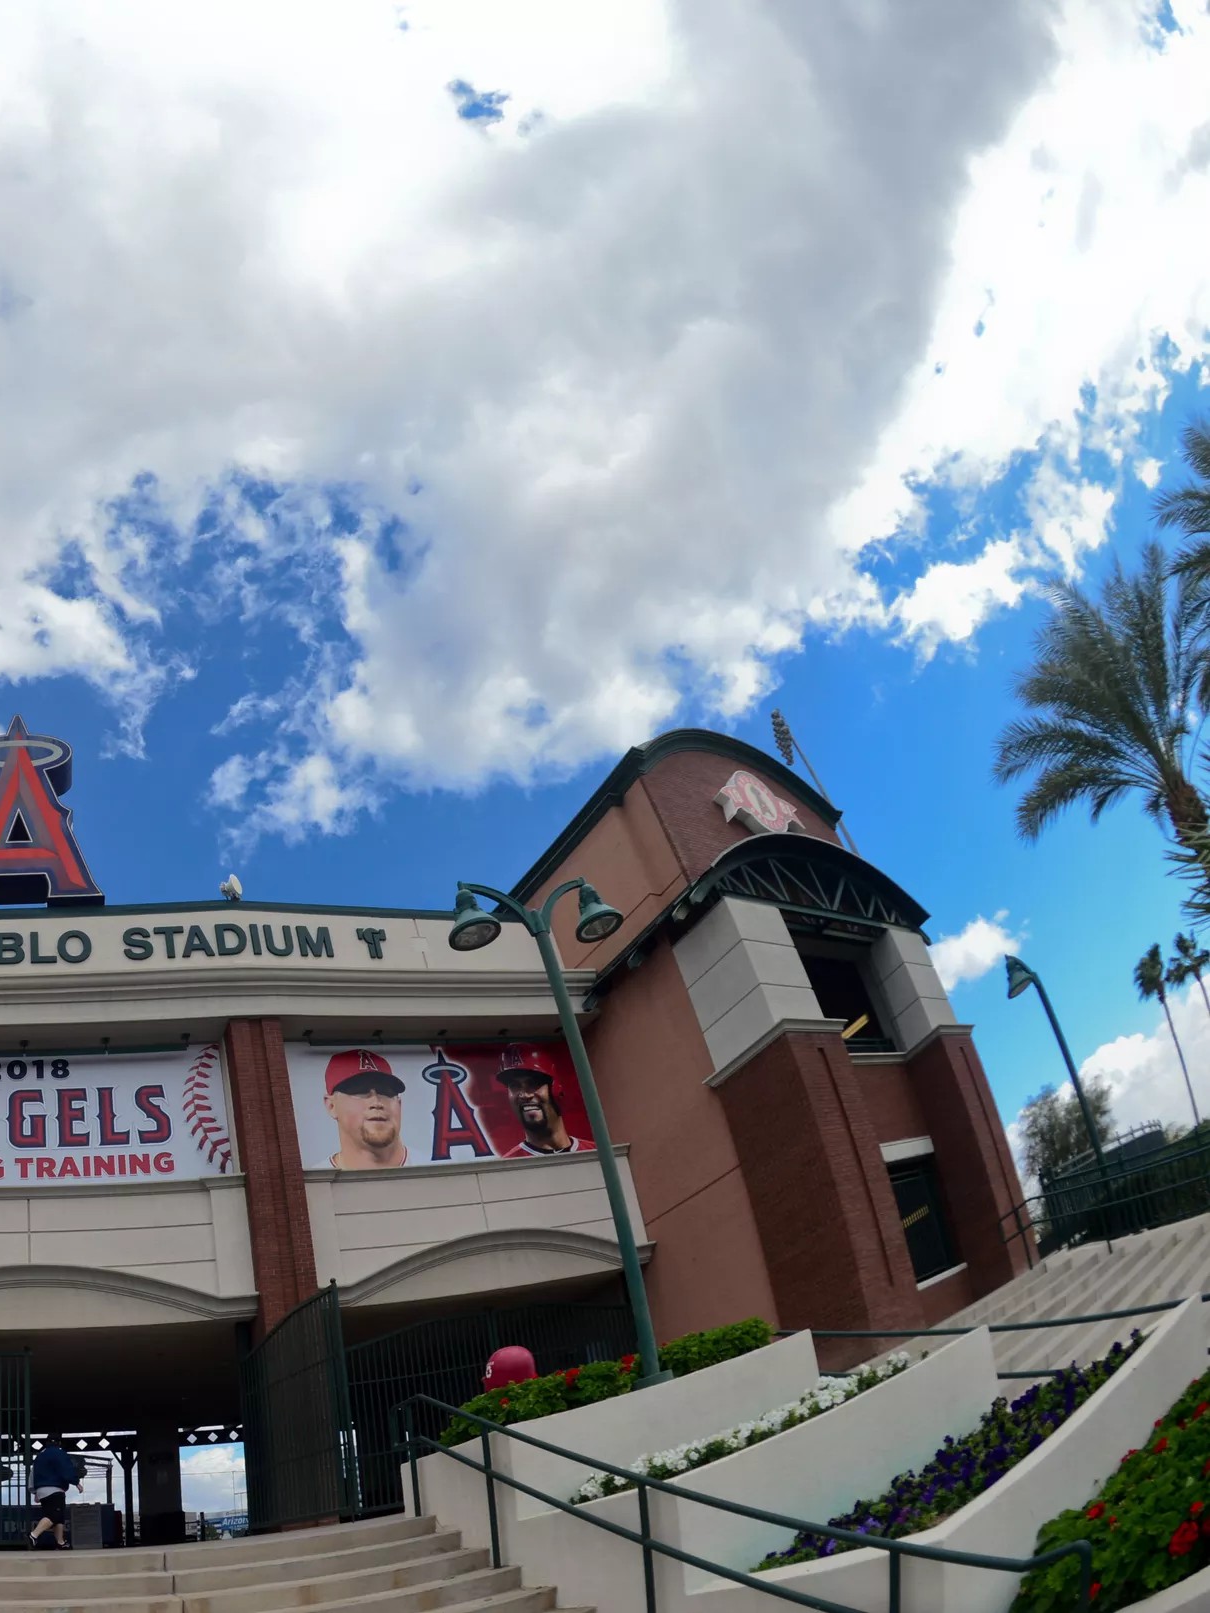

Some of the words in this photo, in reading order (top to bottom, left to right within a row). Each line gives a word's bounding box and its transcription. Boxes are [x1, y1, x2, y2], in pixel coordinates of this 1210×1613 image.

[122, 923, 335, 961] STADIUM
[358, 1050, 378, 1071] A
[422, 1048, 495, 1161] A
[15, 1151, 175, 1179] TRAINING
